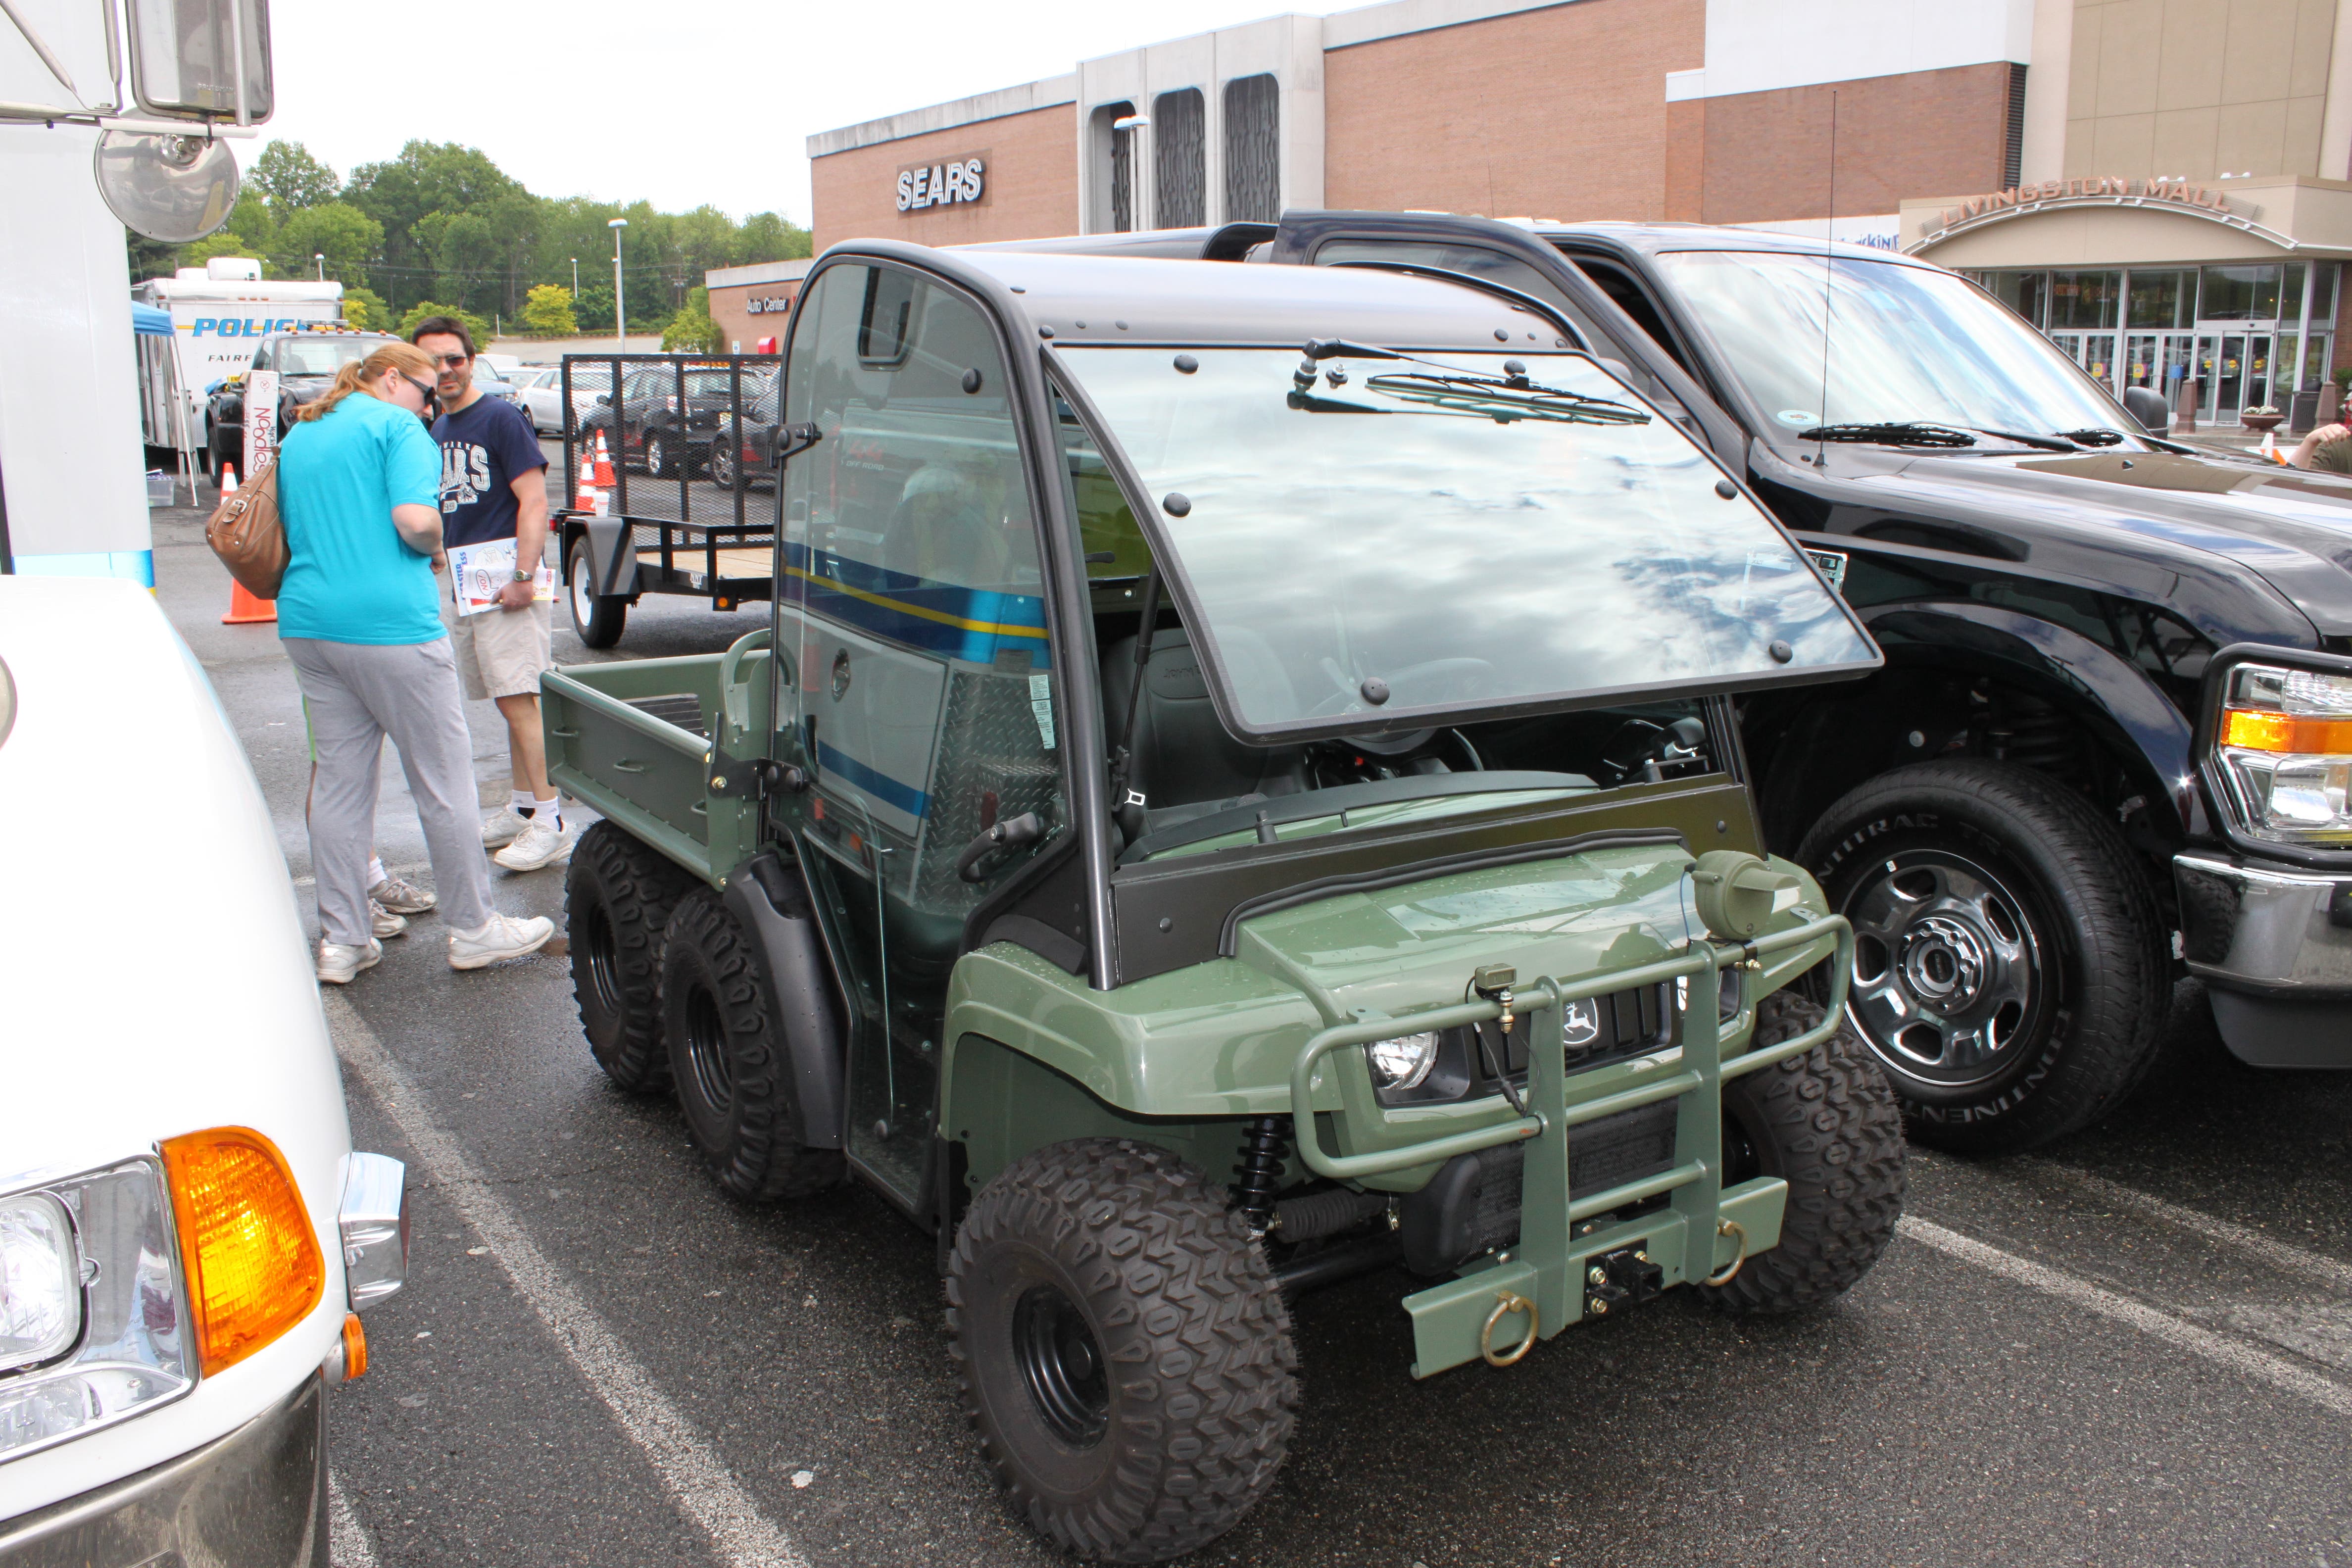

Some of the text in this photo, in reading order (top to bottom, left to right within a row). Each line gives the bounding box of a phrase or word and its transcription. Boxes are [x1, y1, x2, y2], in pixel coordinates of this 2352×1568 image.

[896, 157, 983, 211] SEARS
[1941, 176, 2231, 227] LIVINGSTON MALL
[747, 297, 786, 313] Auto Center
[439, 441, 471, 452] WARK
[442, 444, 490, 491] ARS
[1900, 1008, 2071, 1125] CONTINENT
